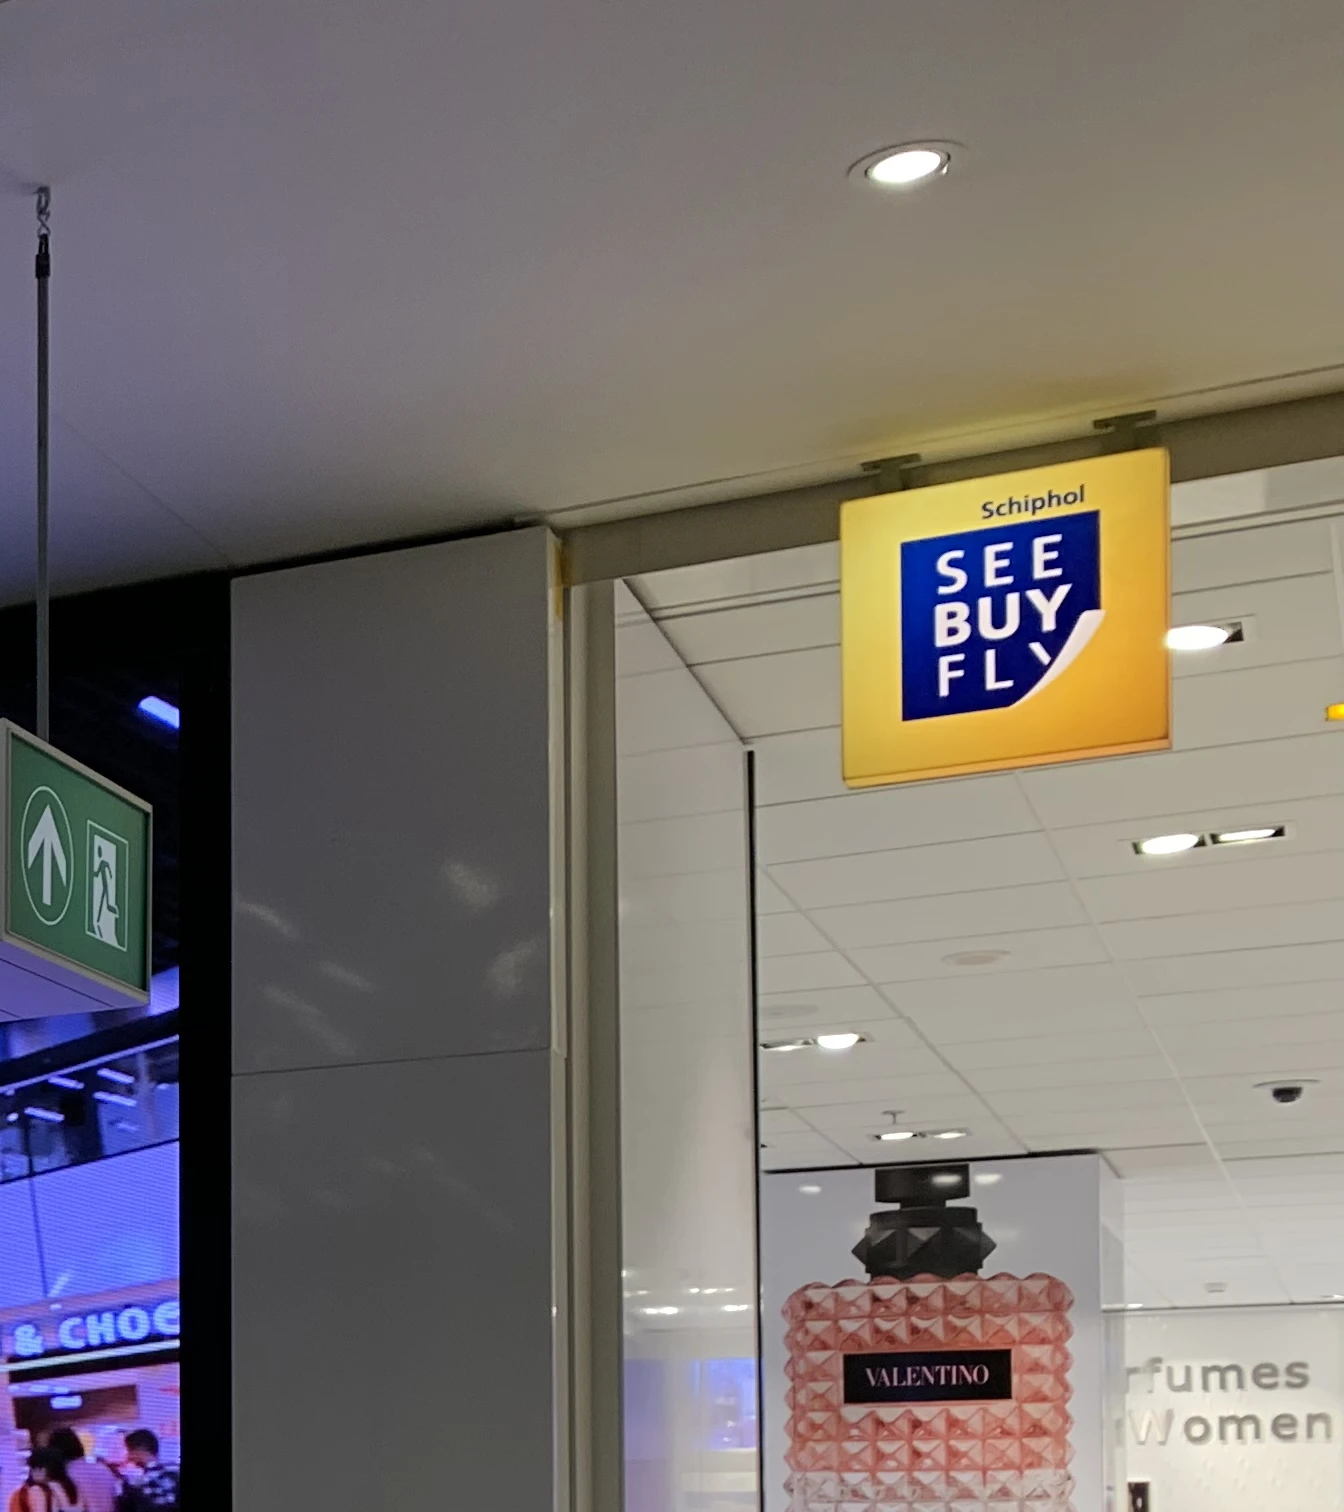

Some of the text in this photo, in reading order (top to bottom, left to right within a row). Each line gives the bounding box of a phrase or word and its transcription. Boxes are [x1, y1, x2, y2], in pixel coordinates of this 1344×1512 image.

[981, 484, 1085, 520] Schiphol
[936, 534, 1063, 595] SEE
[934, 583, 1073, 648] BUY
[14, 1324, 44, 1357] &
[865, 1364, 990, 1387] VALENTINO
[1125, 1356, 1310, 1393] rfumes
[1128, 1409, 1332, 1446] Women
